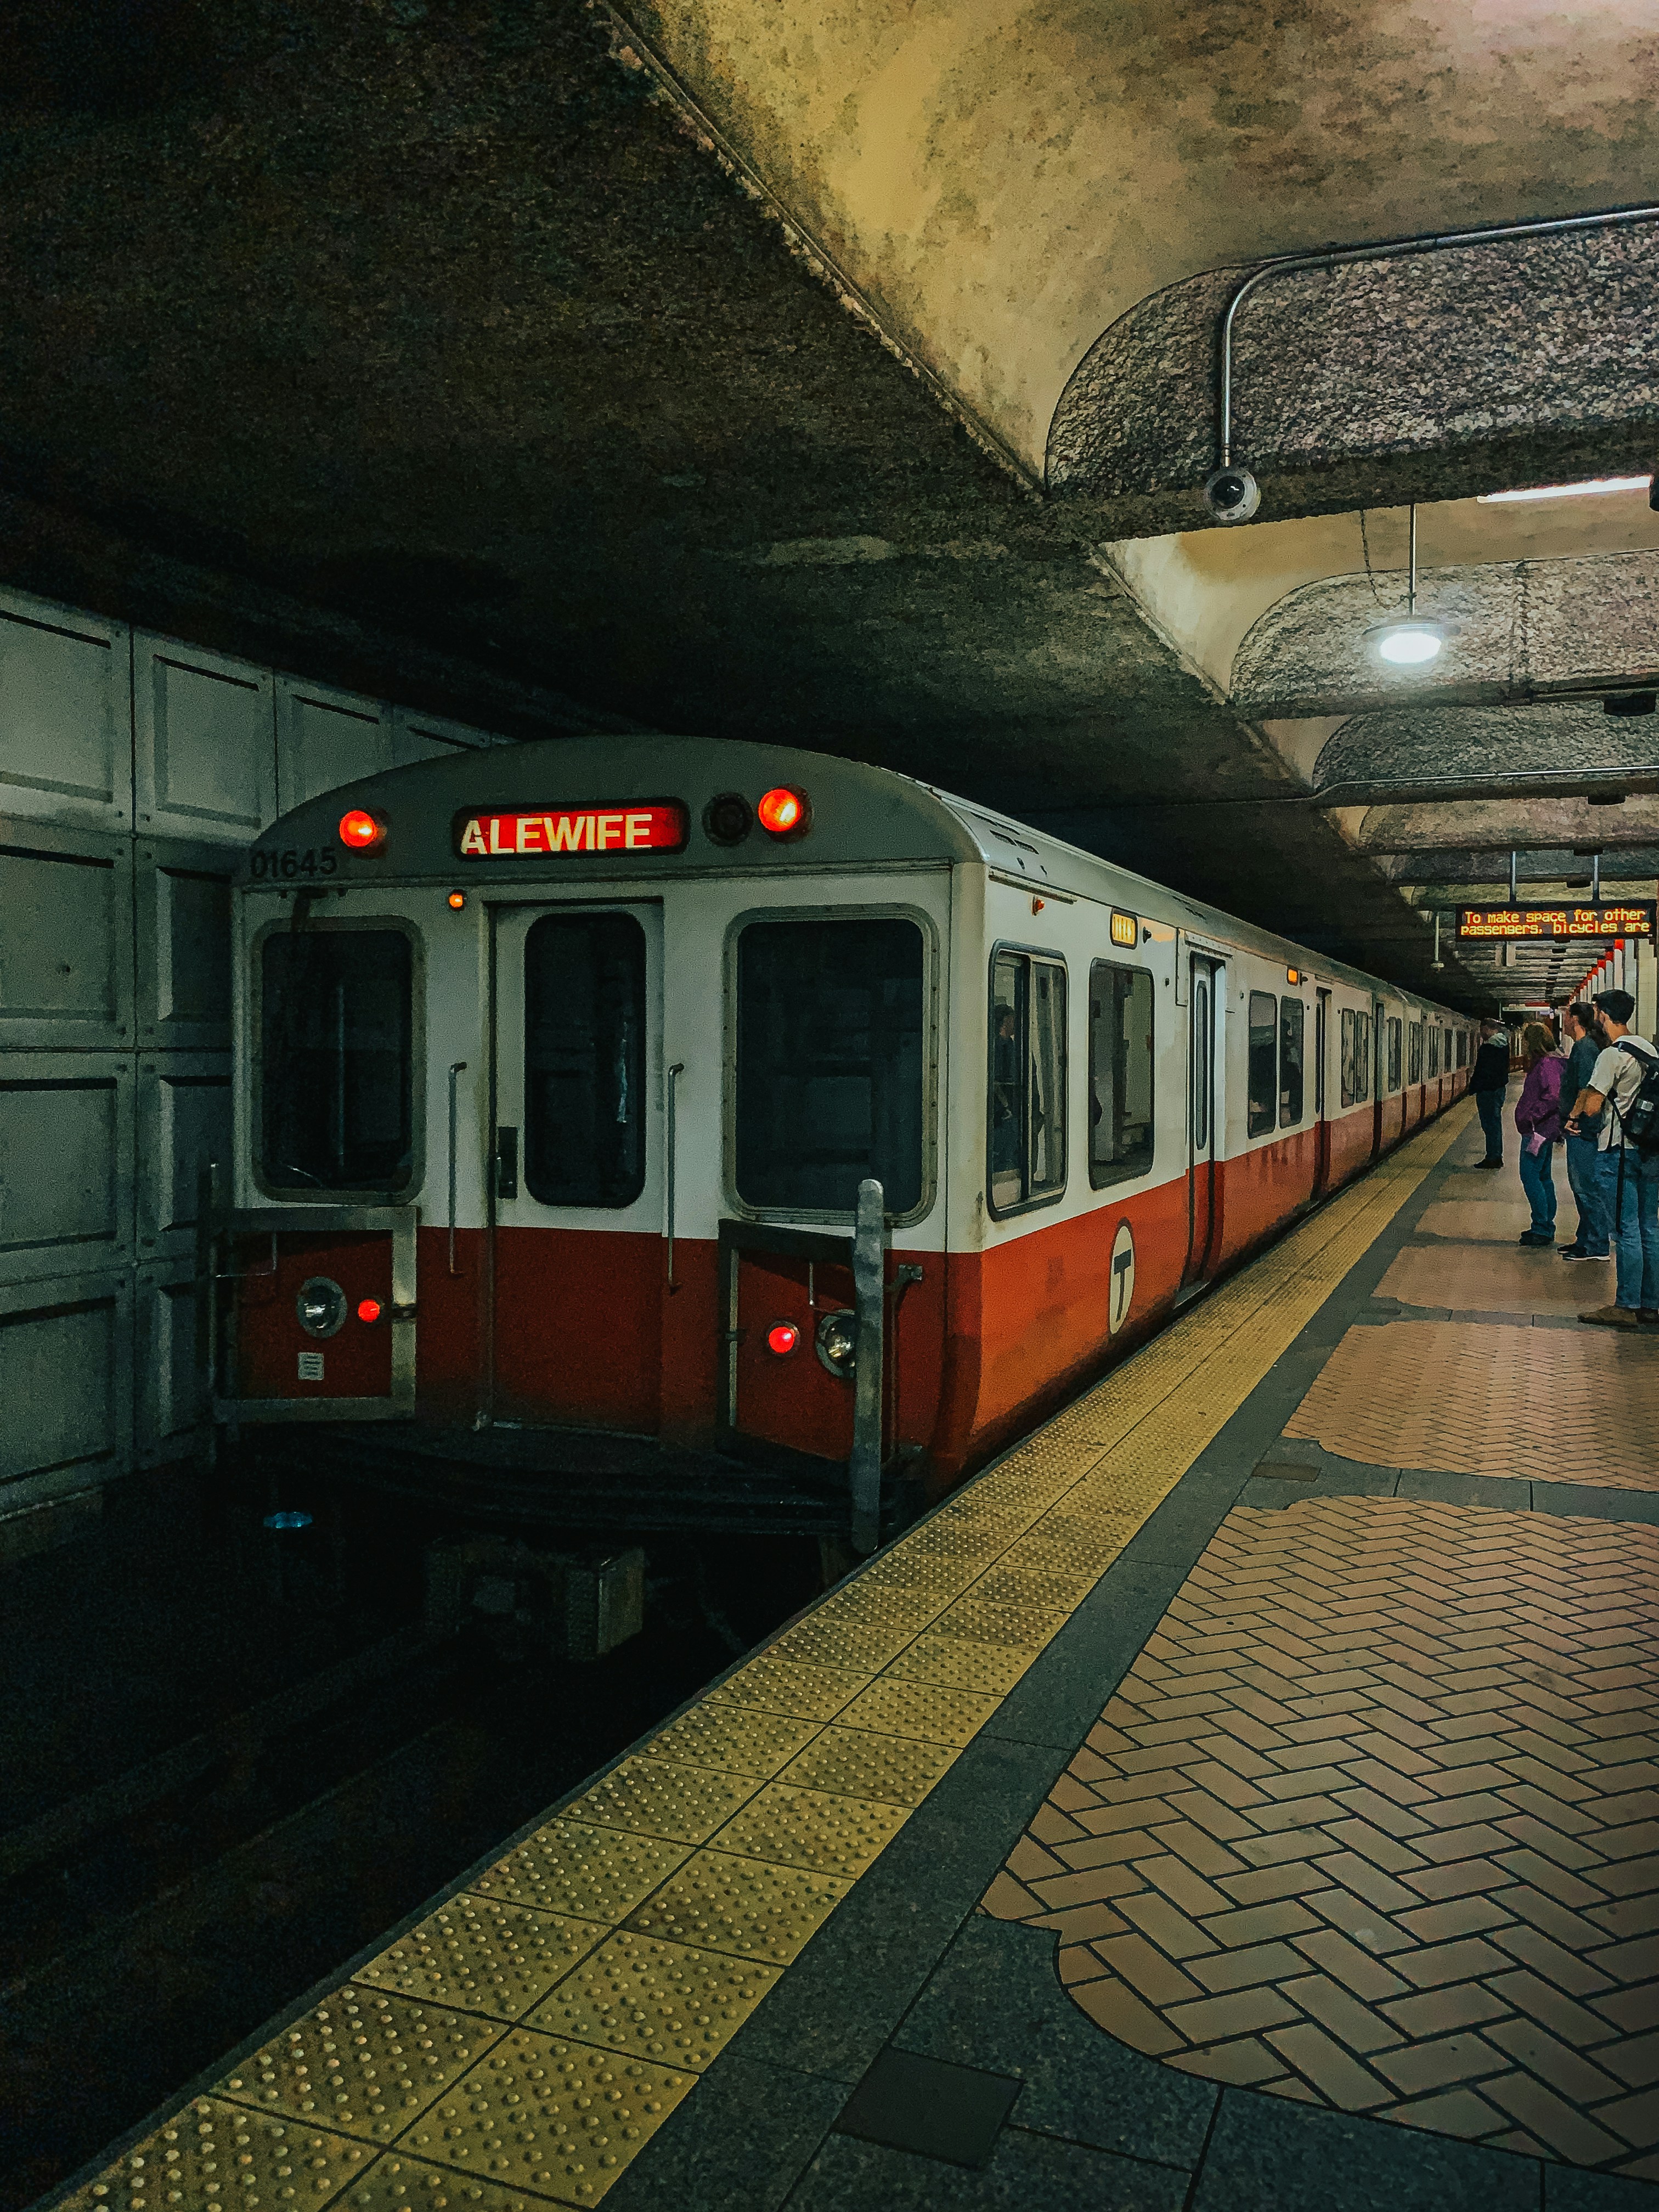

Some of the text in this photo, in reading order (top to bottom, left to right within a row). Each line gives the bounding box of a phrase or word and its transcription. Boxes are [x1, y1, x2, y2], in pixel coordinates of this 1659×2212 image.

[460, 814, 652, 855] ALEWIFE
[250, 847, 337, 878] 01645
[1465, 908, 1646, 924] To make space for other
[1553, 921, 1617, 934] bicycles
[1624, 922, 1650, 933] are
[1114, 1249, 1132, 1323] T
